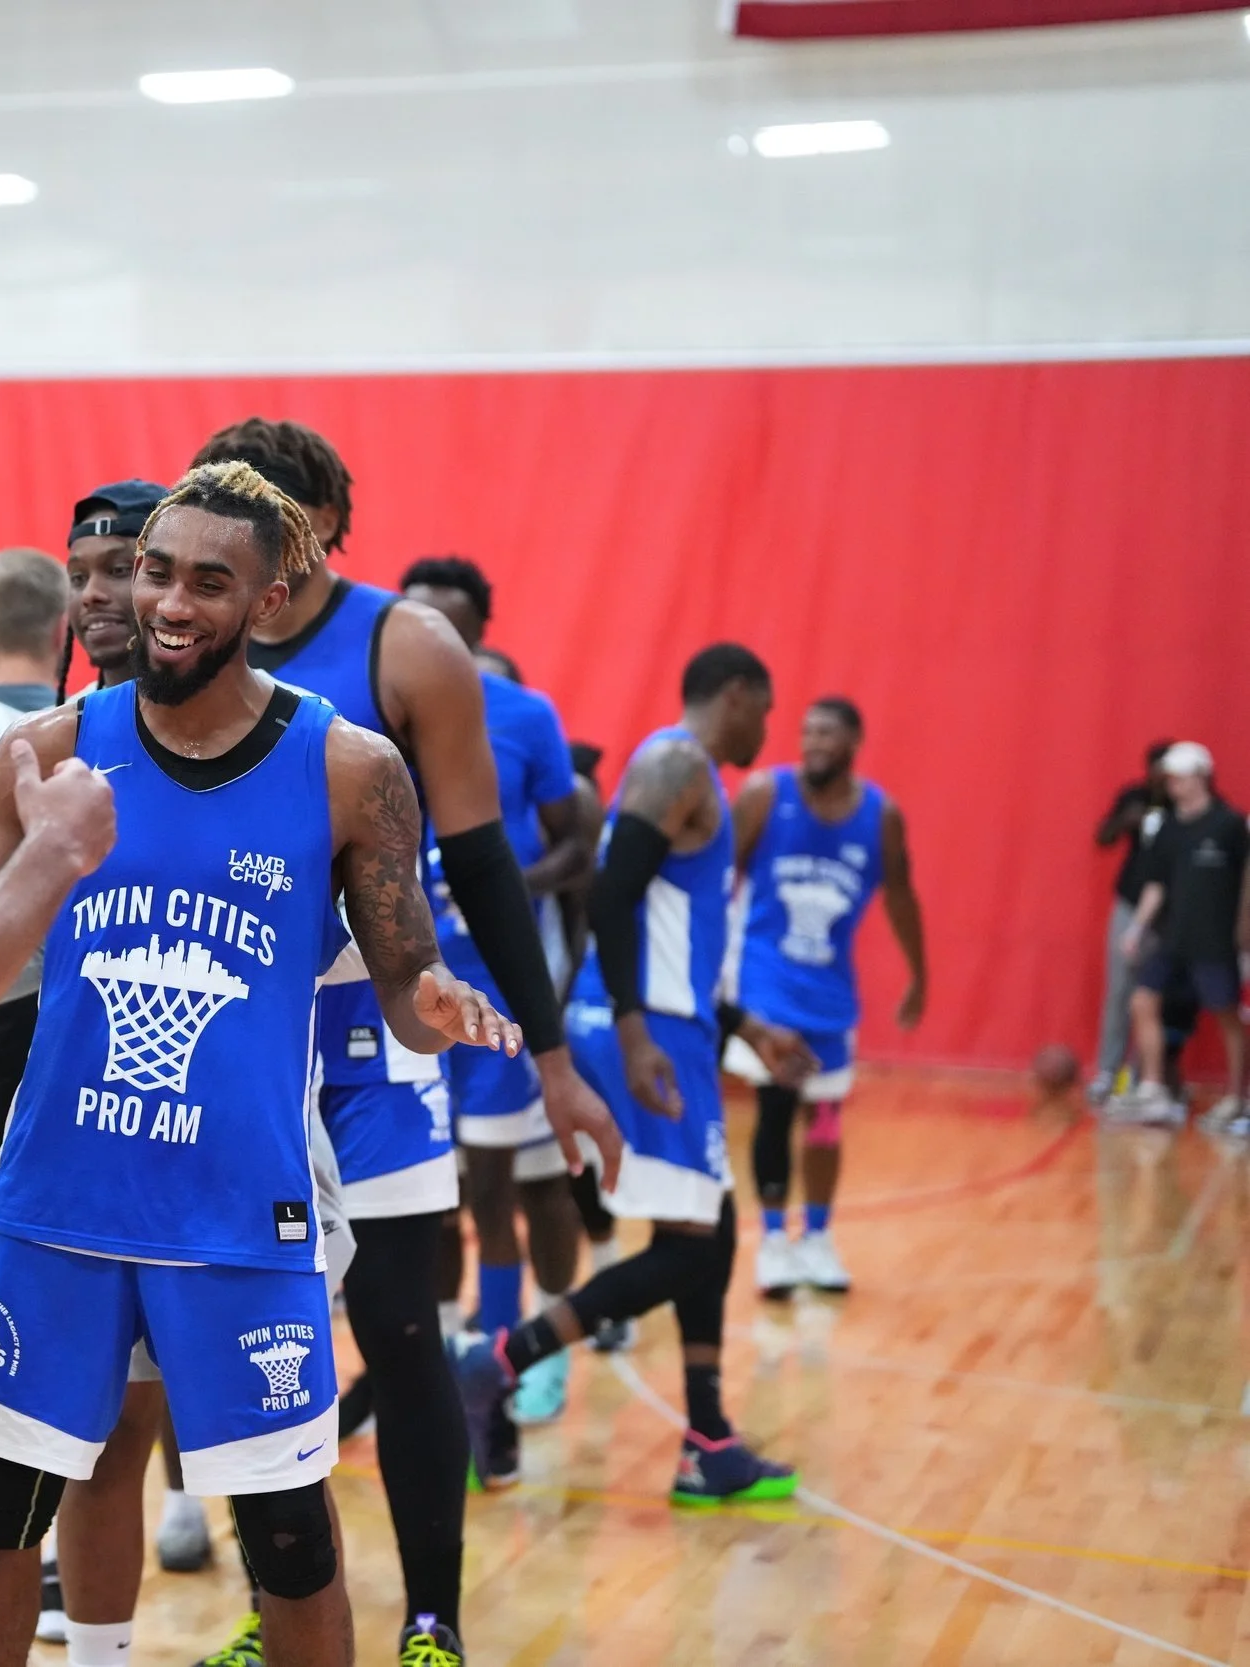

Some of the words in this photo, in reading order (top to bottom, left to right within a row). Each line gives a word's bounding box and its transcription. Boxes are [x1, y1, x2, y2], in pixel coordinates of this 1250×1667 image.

[228, 849, 285, 874] LAMB
[73, 886, 153, 939] TWIN
[166, 888, 276, 966] CITIES
[75, 1087, 143, 1136] PRO
[149, 1101, 202, 1144] AM
[287, 1206, 295, 1218] L
[6, 1316, 20, 1347] LEGACY
[238, 1326, 271, 1350] TWIN
[275, 1324, 314, 1340] CITIES
[13, 1348, 20, 1359] OF
[9, 1359, 19, 1377] MEN
[262, 1395, 289, 1411] PRO
[293, 1390, 310, 1407] AM
